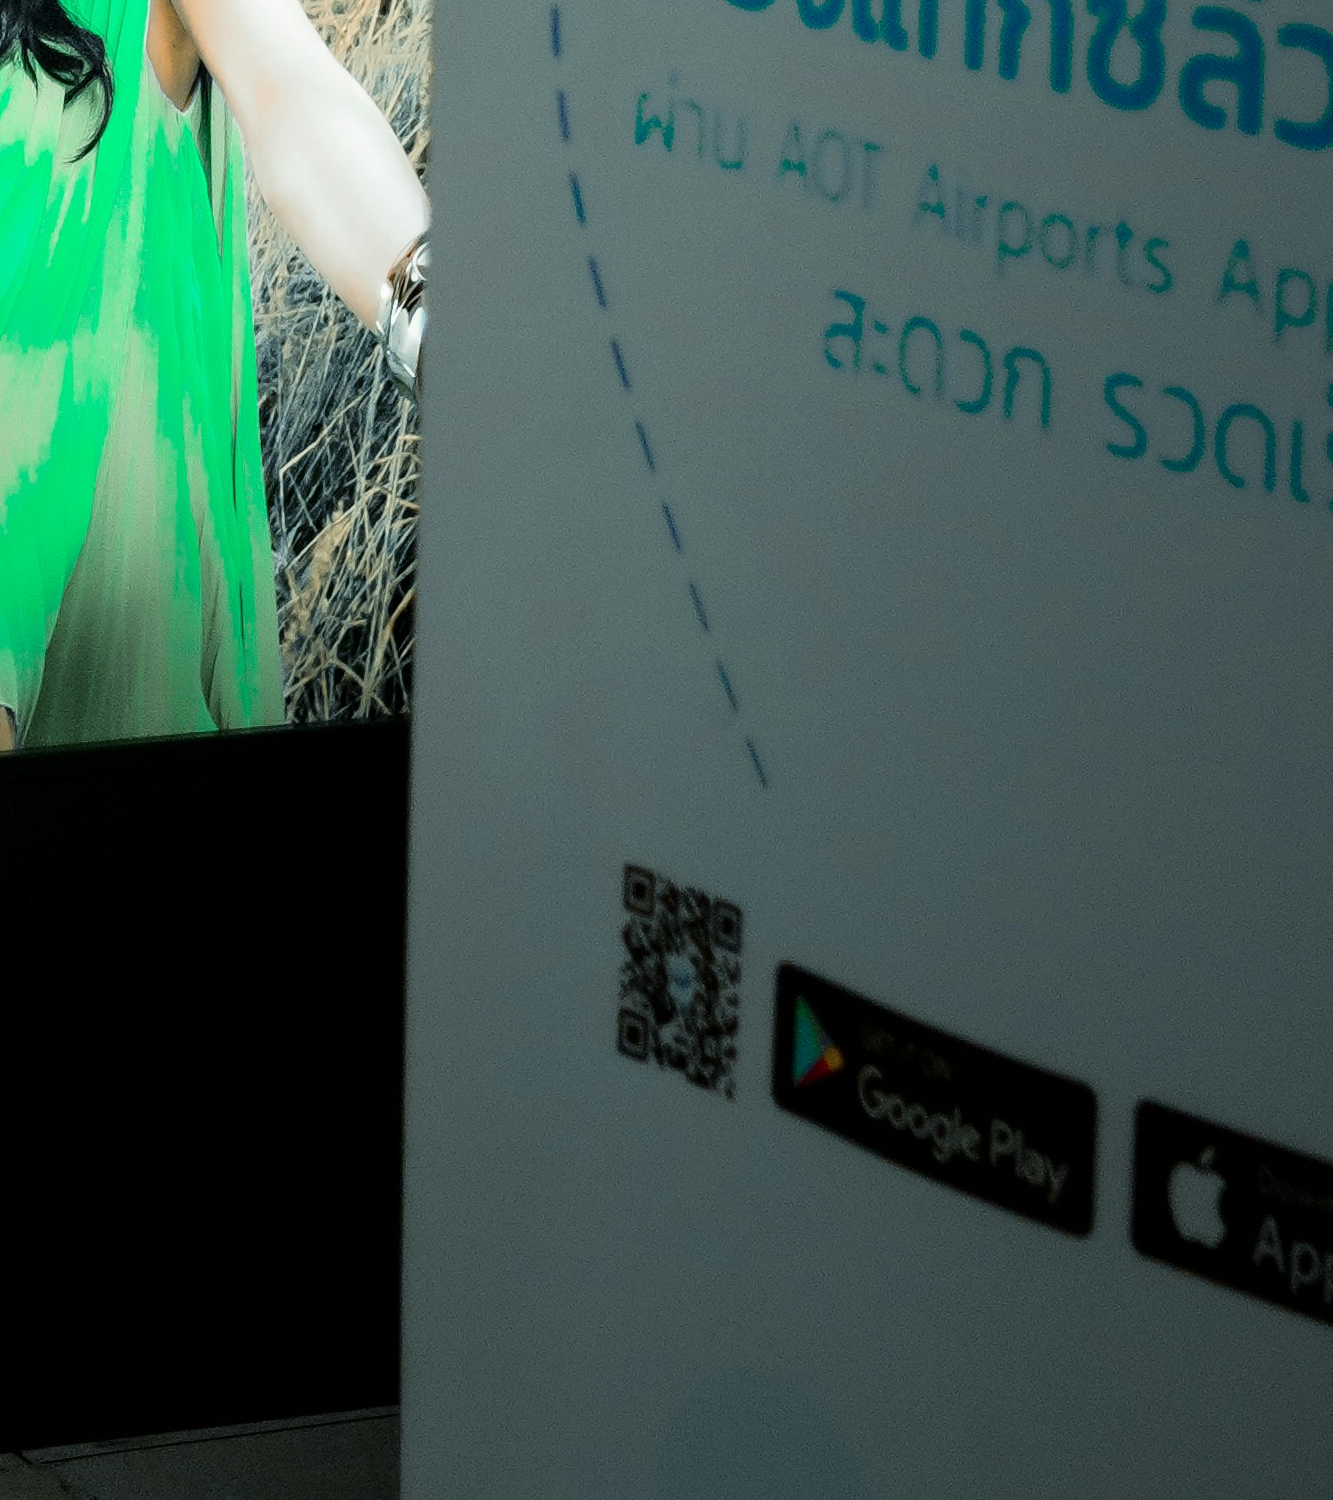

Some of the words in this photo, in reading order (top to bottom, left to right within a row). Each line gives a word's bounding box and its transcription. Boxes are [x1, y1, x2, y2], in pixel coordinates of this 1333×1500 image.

[778, 116, 882, 210] AOT
[914, 162, 1173, 293] Airports
[1218, 238, 1333, 357] Ap
[1104, 372, 1333, 512] รวดเ
[856, 1064, 979, 1164] Google
[989, 1116, 1070, 1205] Play
